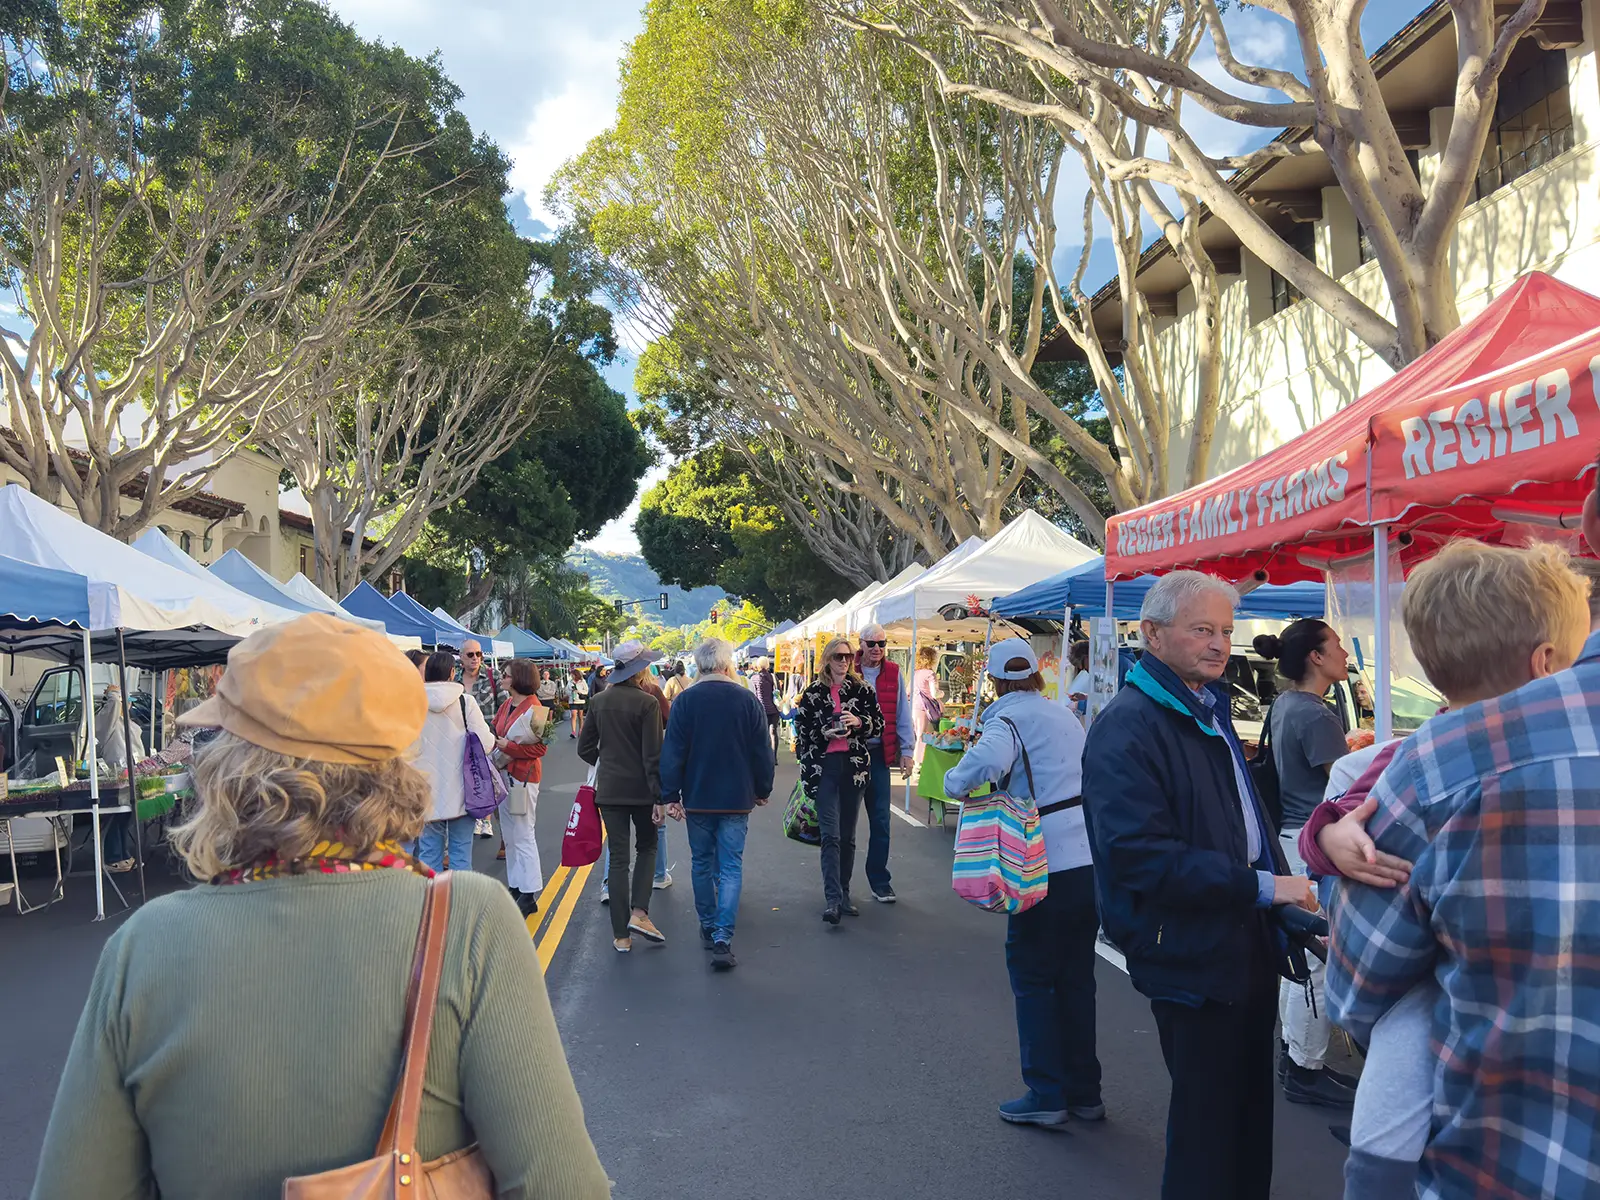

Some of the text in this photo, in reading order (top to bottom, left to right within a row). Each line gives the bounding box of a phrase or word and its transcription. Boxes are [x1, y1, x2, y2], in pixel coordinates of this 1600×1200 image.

[1400, 367, 1579, 480] REGIER
[1117, 450, 1349, 557] REGIER FAMILY FARMS
